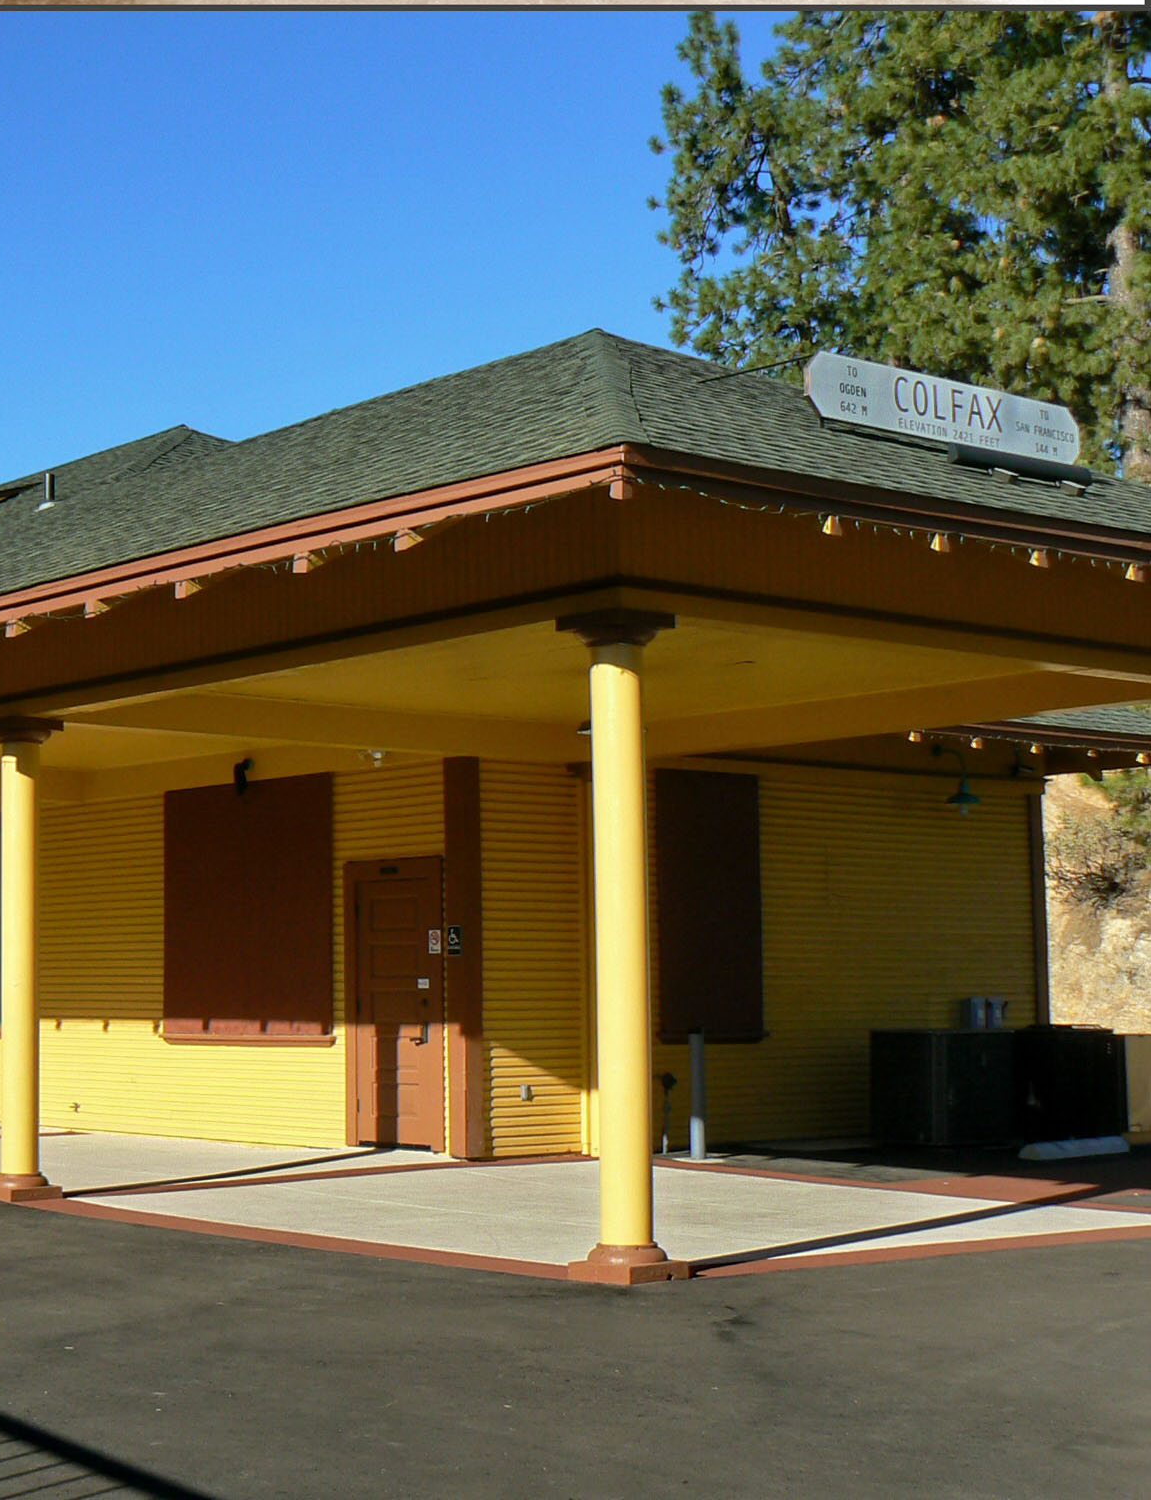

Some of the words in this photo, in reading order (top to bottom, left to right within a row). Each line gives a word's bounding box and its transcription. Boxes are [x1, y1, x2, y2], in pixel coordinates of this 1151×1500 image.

[846, 365, 858, 378] TO
[839, 382, 867, 398] OGDEN
[840, 400, 857, 415] 642
[893, 376, 1003, 433] COLFAX
[1039, 409, 1050, 421] TO
[898, 417, 948, 437] ELEVATION
[979, 435, 1000, 448] FEET
[1015, 420, 1030, 433] SAN
[1034, 425, 1075, 443] FRANCISCO
